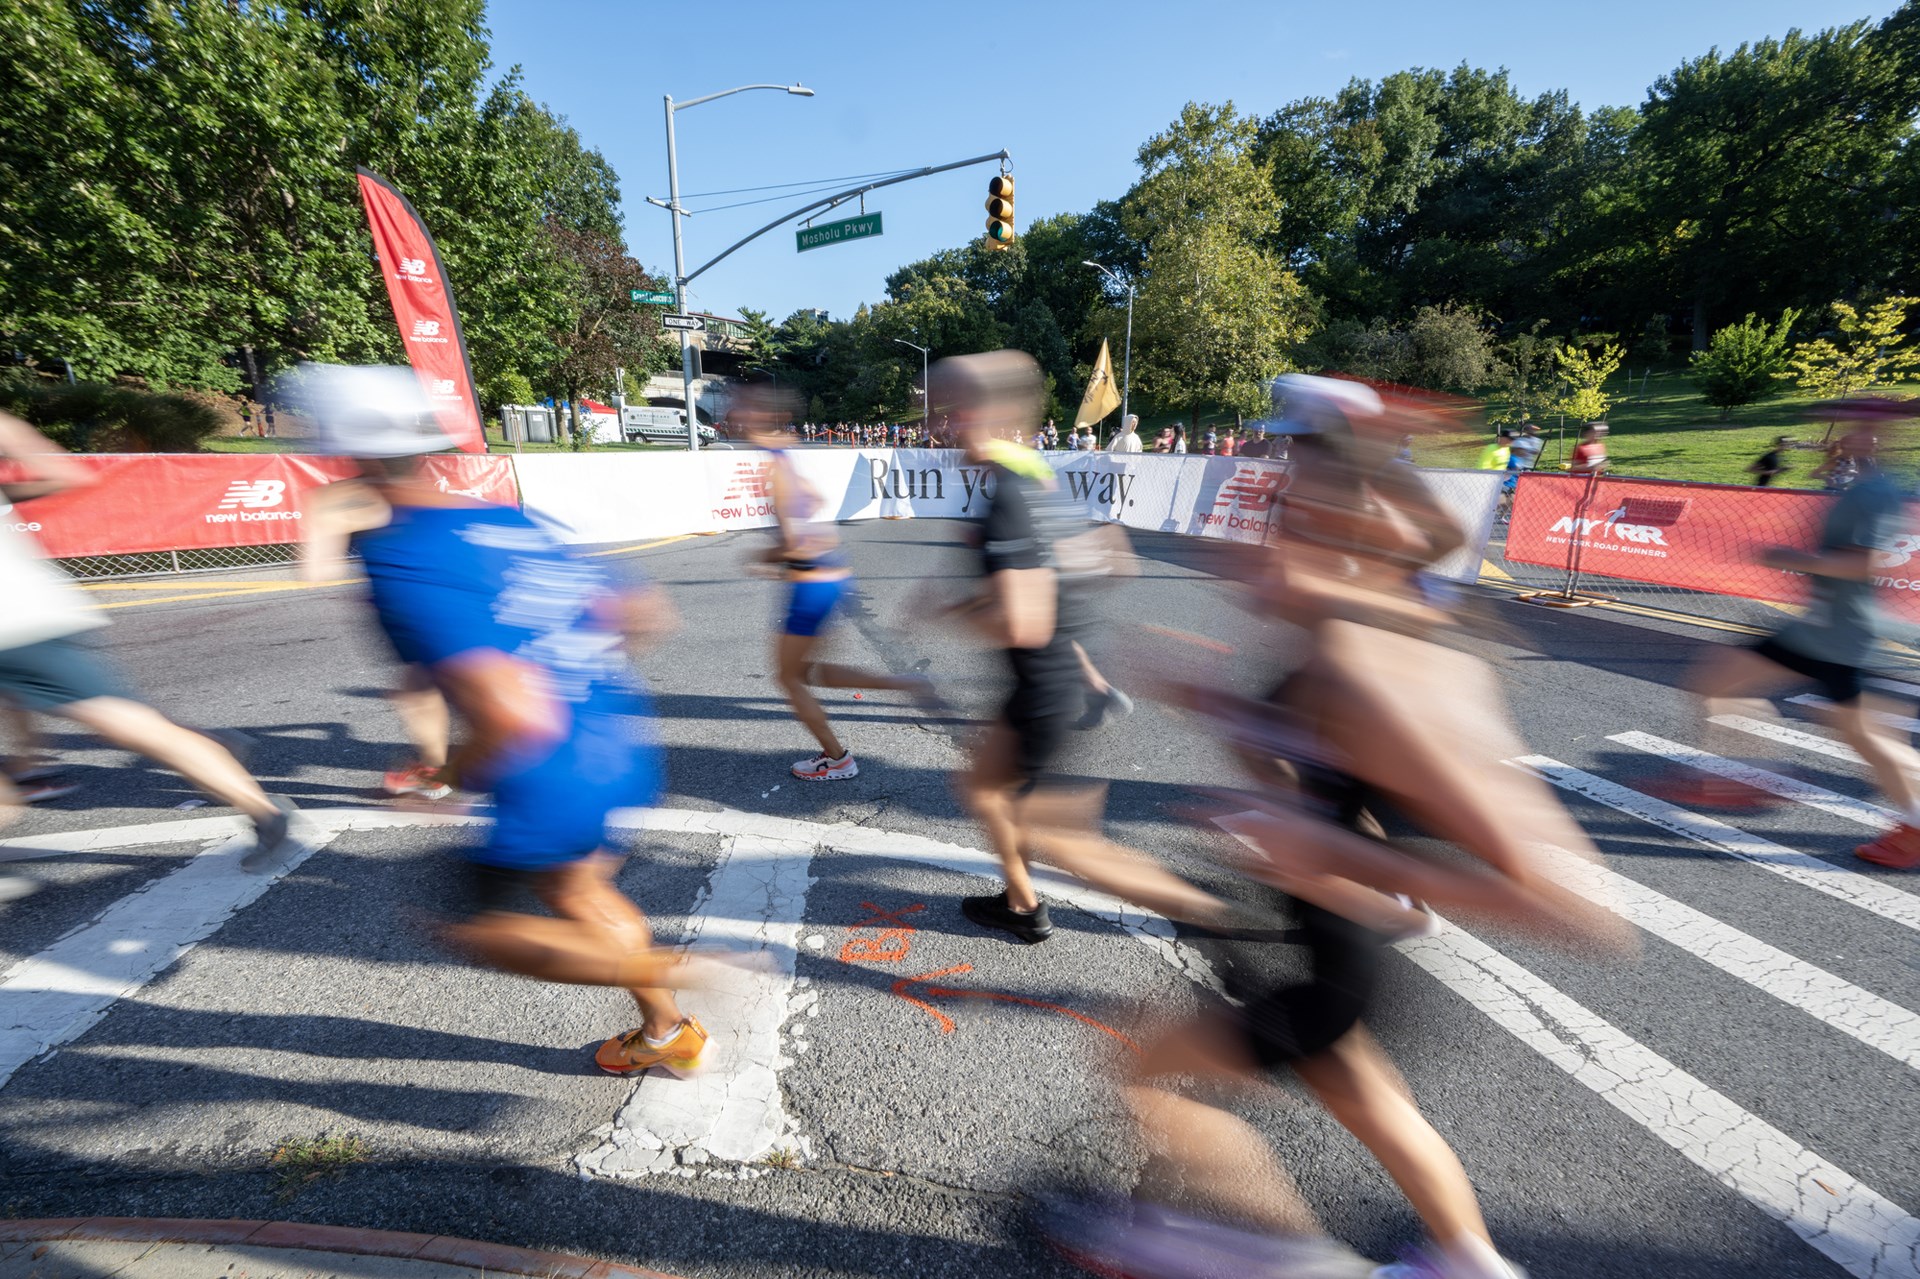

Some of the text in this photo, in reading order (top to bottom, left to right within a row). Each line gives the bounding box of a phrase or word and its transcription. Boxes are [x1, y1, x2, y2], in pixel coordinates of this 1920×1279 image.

[801, 222, 874, 246] Mosholu Pkwy
[408, 275, 432, 283] balance
[668, 318, 699, 327] ONE WAY
[869, 457, 1136, 520] Run yo way.
[205, 510, 303, 524] new balance
[711, 502, 777, 520] new bala
[1197, 512, 1281, 535] new balanc
[1546, 535, 1668, 559] NEW YORK ROAD RUNNERS
[1871, 575, 1920, 592] ance
